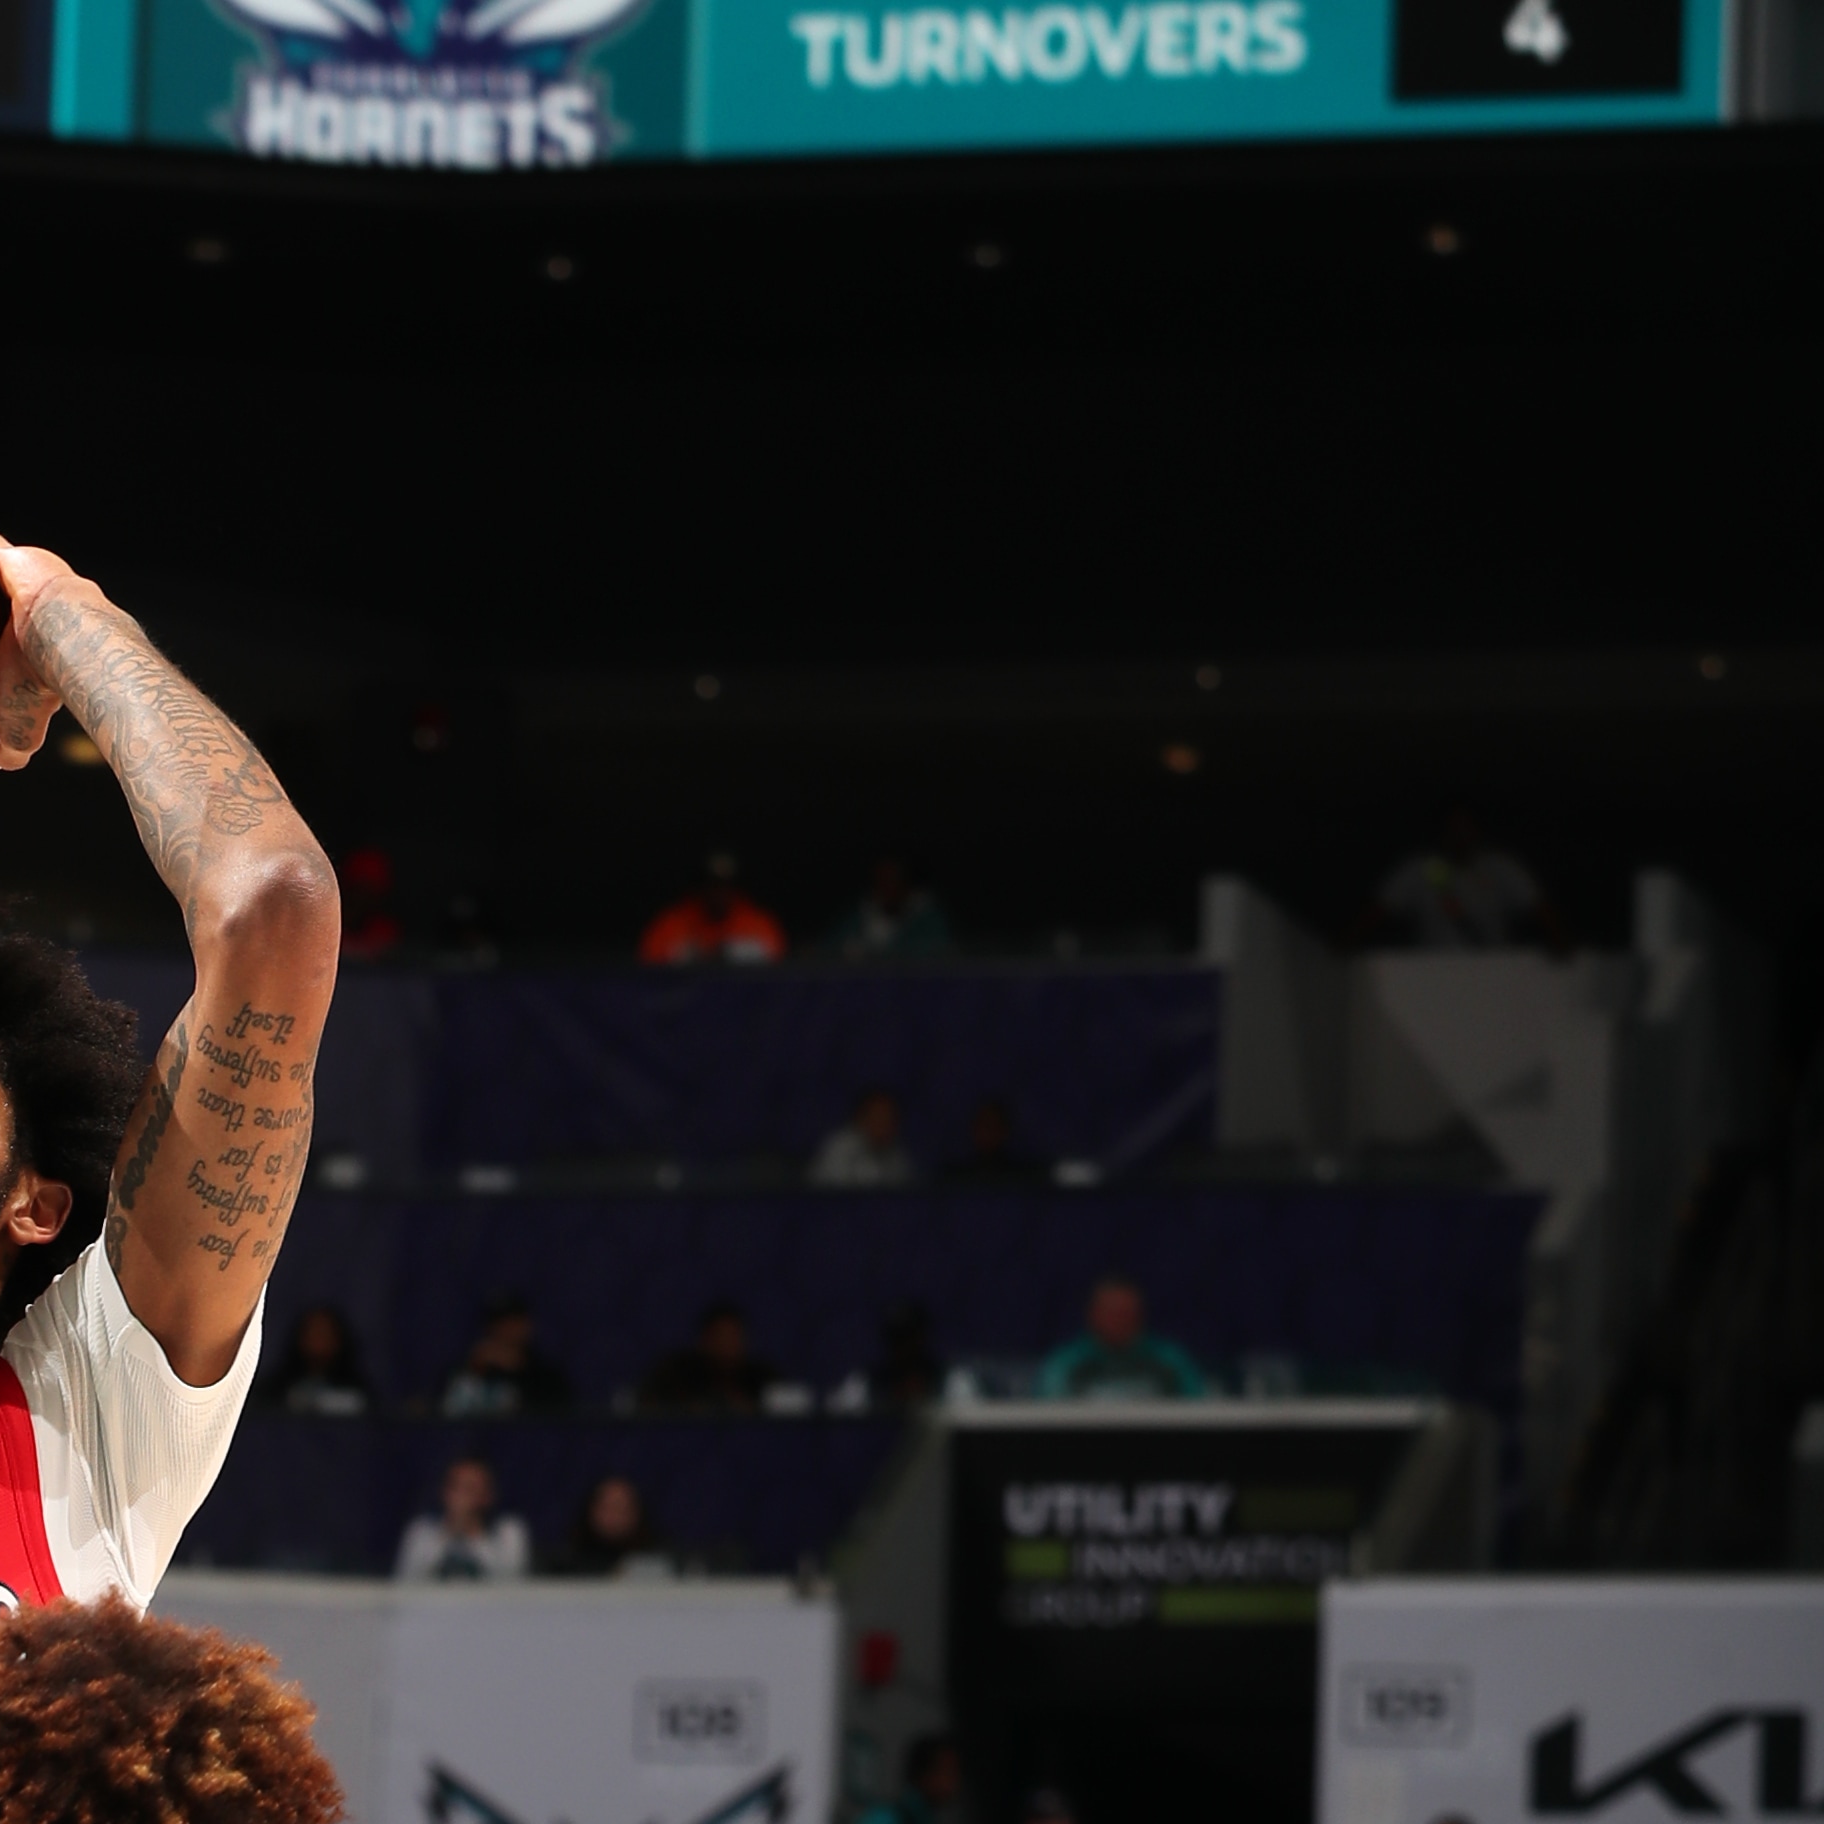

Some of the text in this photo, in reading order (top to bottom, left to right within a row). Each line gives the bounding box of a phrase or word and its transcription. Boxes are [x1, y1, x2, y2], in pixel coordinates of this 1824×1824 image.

[788, 0, 1308, 88] TURNOVERS
[1502, 0, 1569, 62] 4
[243, 77, 599, 170] HORNETS
[196, 1024, 281, 1089] suffering
[197, 1088, 246, 1133] than
[218, 1140, 283, 1185] is far
[187, 1160, 270, 1228] suffering
[197, 1228, 251, 1272] fear
[1004, 1482, 1234, 1536] UTILITY
